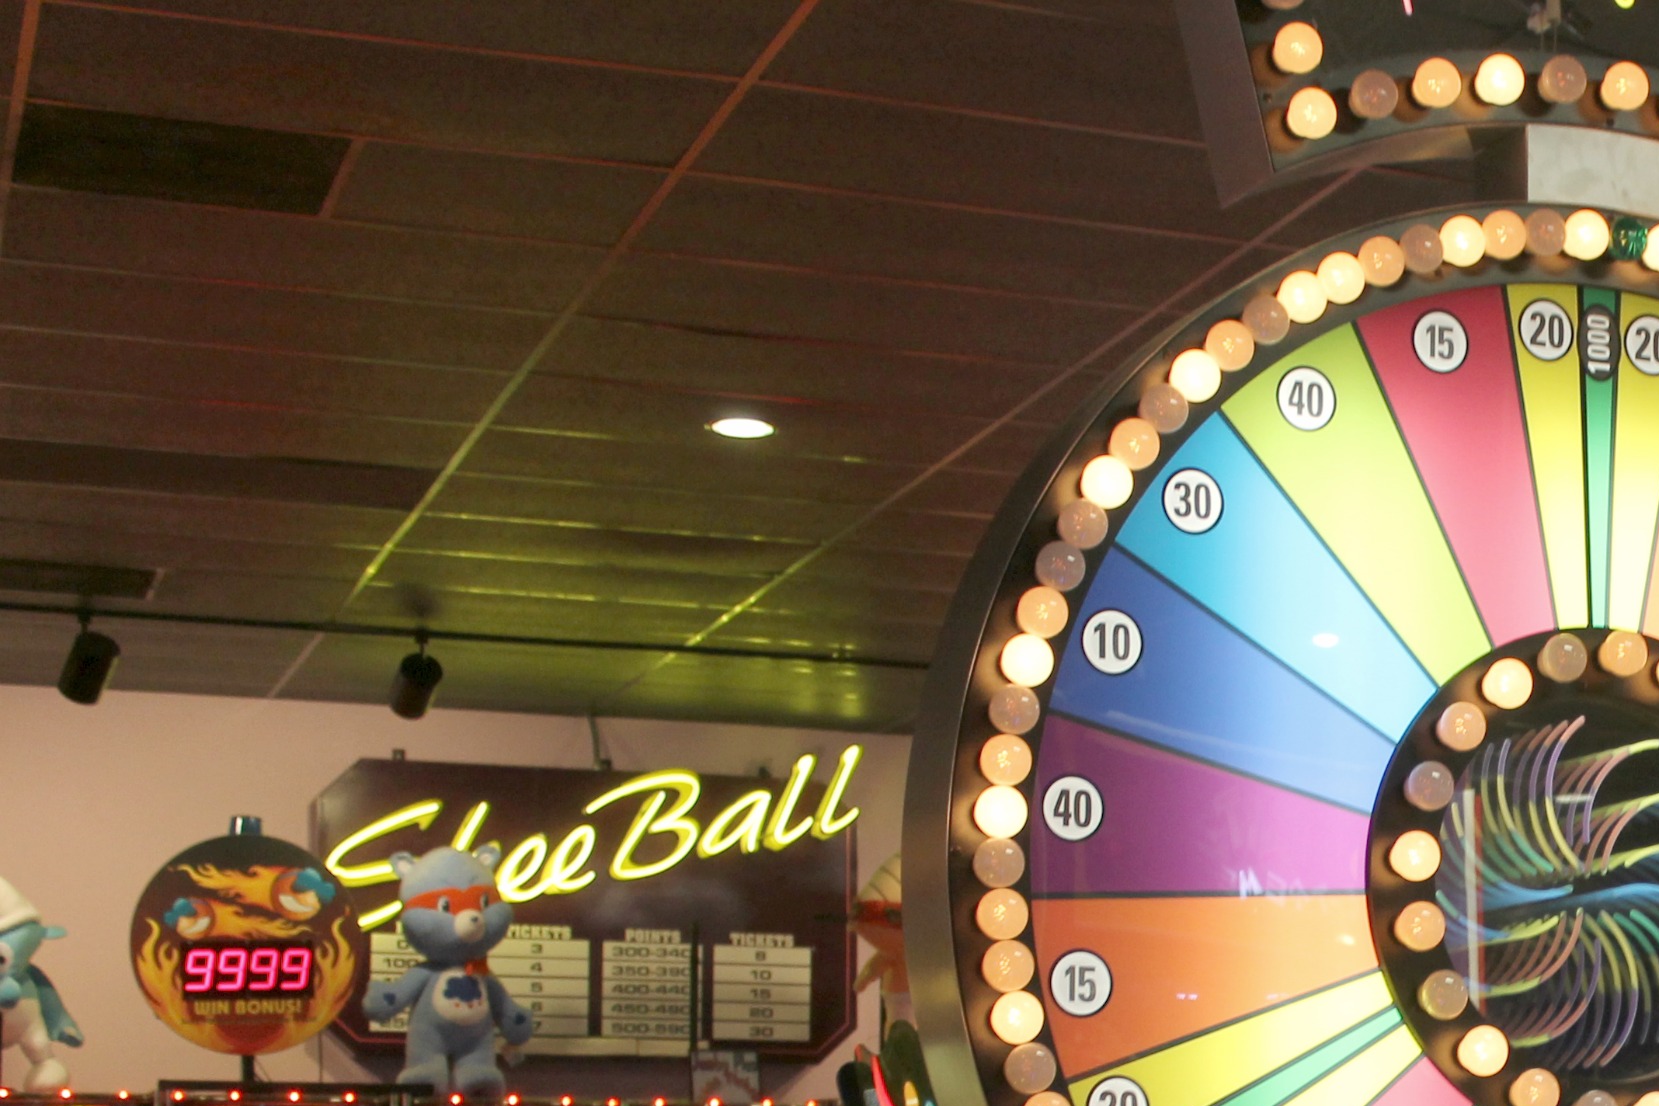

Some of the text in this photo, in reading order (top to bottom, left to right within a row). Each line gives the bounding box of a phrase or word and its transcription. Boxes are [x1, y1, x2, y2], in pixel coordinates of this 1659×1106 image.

[1425, 324, 1455, 360] 15
[1529, 311, 1565, 349] 20
[1586, 313, 1612, 374] 1000
[1288, 381, 1324, 417] 40
[1173, 481, 1211, 519] 30
[1093, 622, 1130, 661] 10
[1053, 788, 1092, 828] 40
[326, 744, 863, 930] See Ball
[184, 947, 313, 993] 9999
[750, 970, 772, 981] 10
[1064, 965, 1096, 1003] 15
[194, 1000, 231, 1015] WIN
